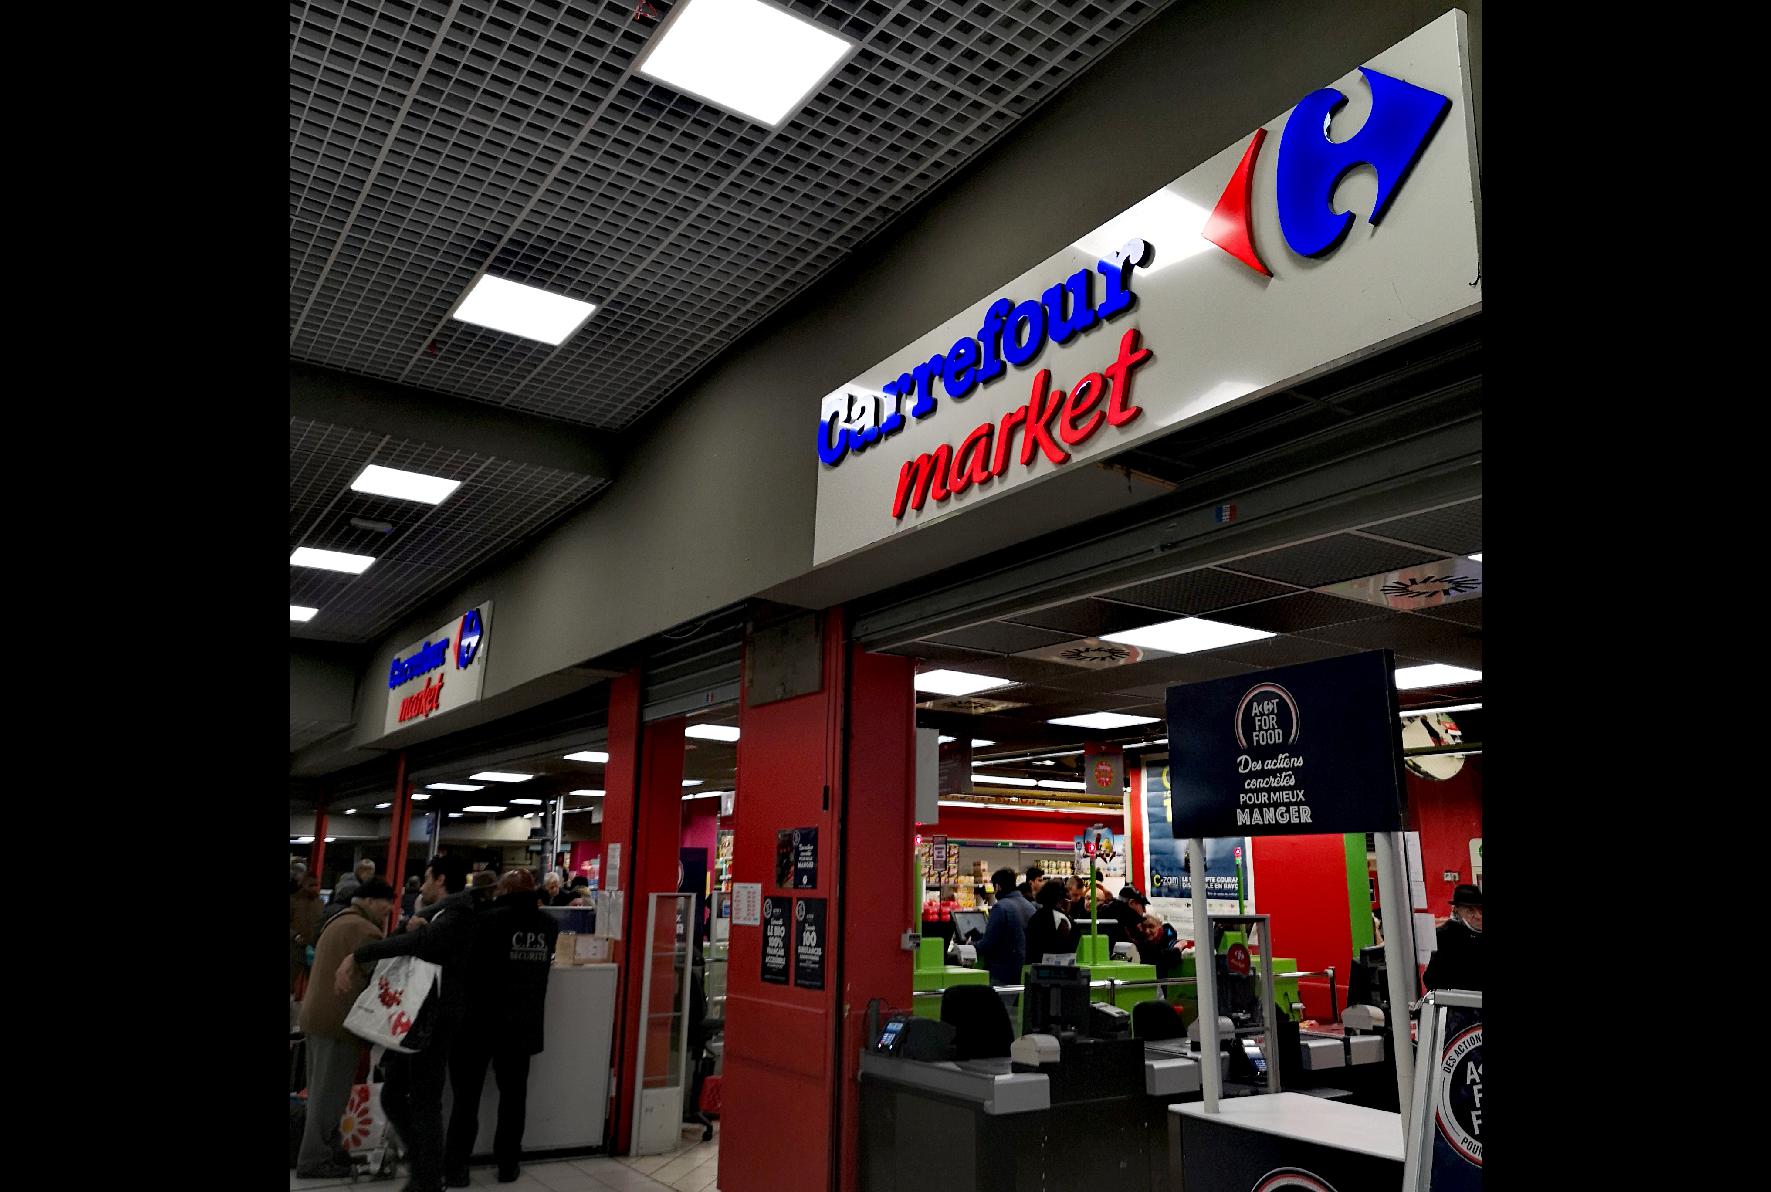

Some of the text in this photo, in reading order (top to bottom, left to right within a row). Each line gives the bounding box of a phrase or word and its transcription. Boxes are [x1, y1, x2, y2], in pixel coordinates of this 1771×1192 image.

[817, 237, 1154, 466] Carrefour
[892, 328, 1152, 520] market
[1254, 715, 1278, 731] FOR
[1253, 729, 1283, 746] FOOD
[1237, 753, 1304, 773] Des actions
[1244, 771, 1296, 789] concrètes
[1240, 790, 1306, 805] POUR MIEUX
[1236, 806, 1313, 826] MANGER
[802, 930, 817, 947] 100
[1443, 1033, 1483, 1074] DES ACTION
